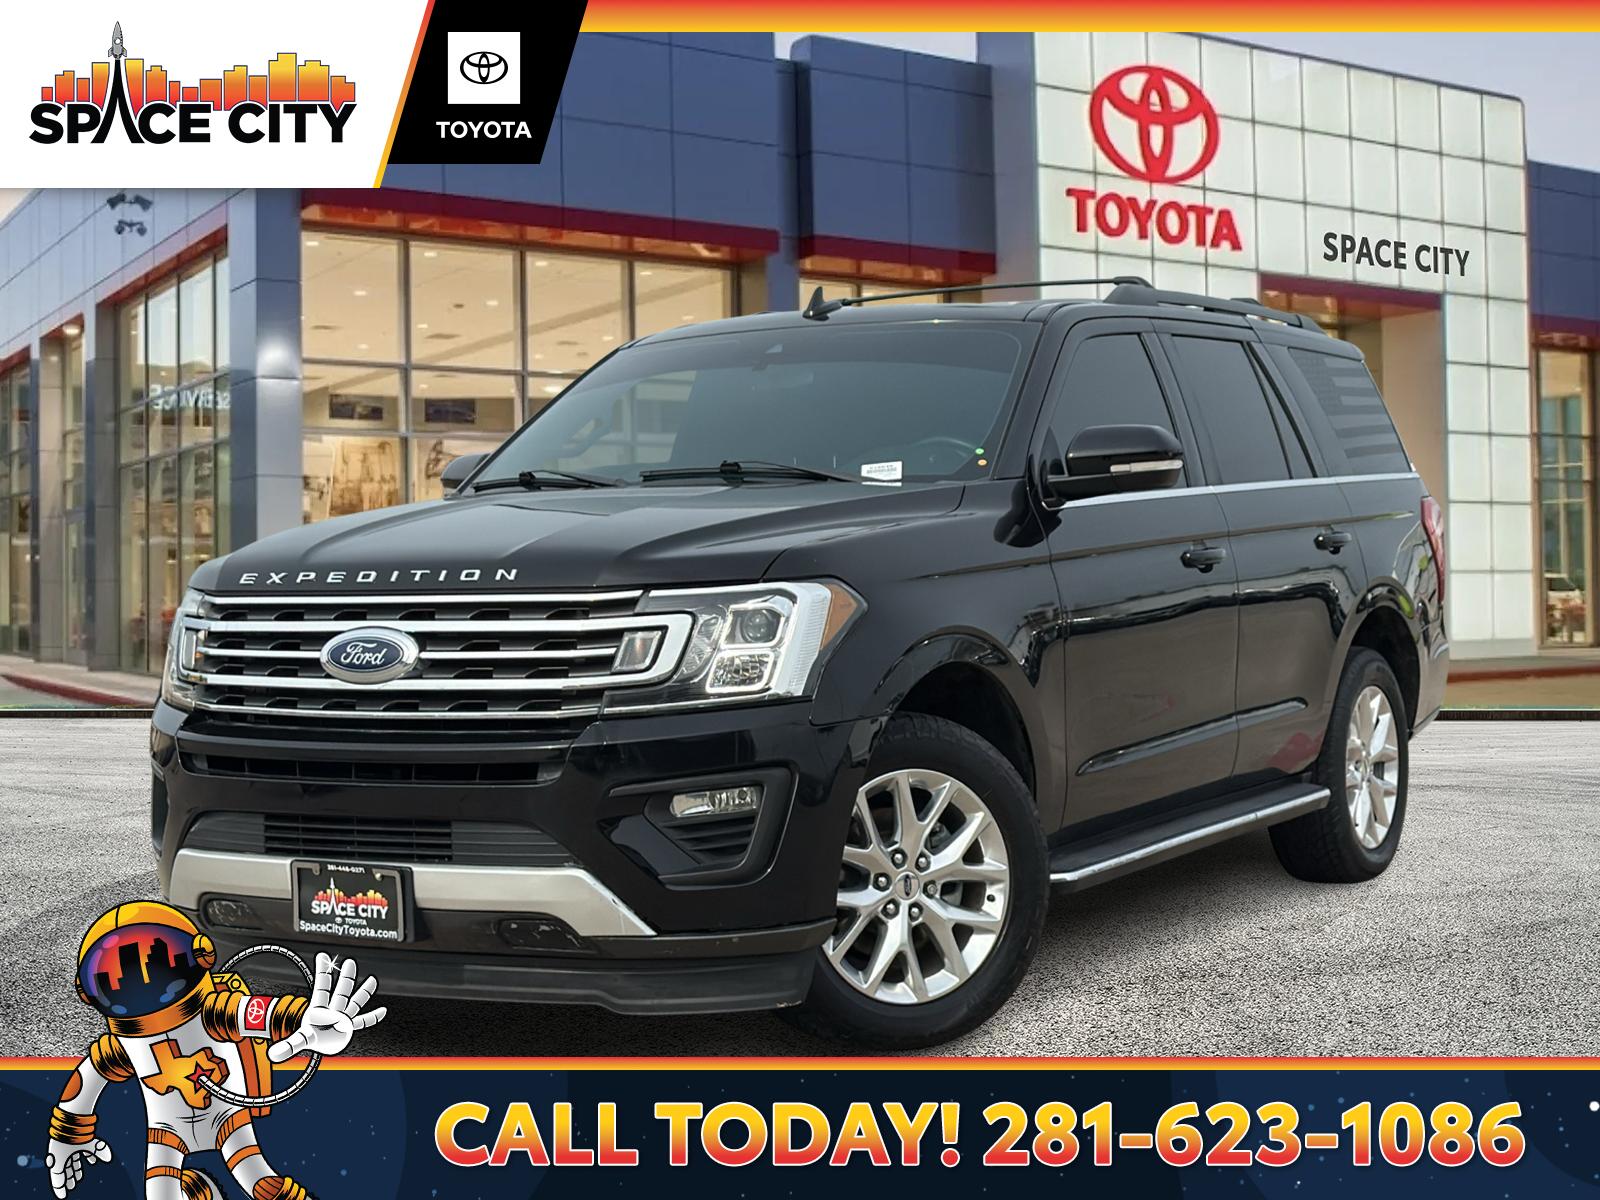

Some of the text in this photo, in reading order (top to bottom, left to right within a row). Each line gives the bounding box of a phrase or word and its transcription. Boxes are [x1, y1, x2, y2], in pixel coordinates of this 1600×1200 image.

[1066, 188, 1243, 251] TOYOTA
[1323, 232, 1470, 277] SPACE CITY
[239, 569, 518, 584] EXPEDITION
[340, 641, 388, 666] Ford
[358, 904, 388, 919] CITY
[300, 920, 397, 938] SpaceCityToyota.com
[345, 918, 367, 926] TOYOTA
